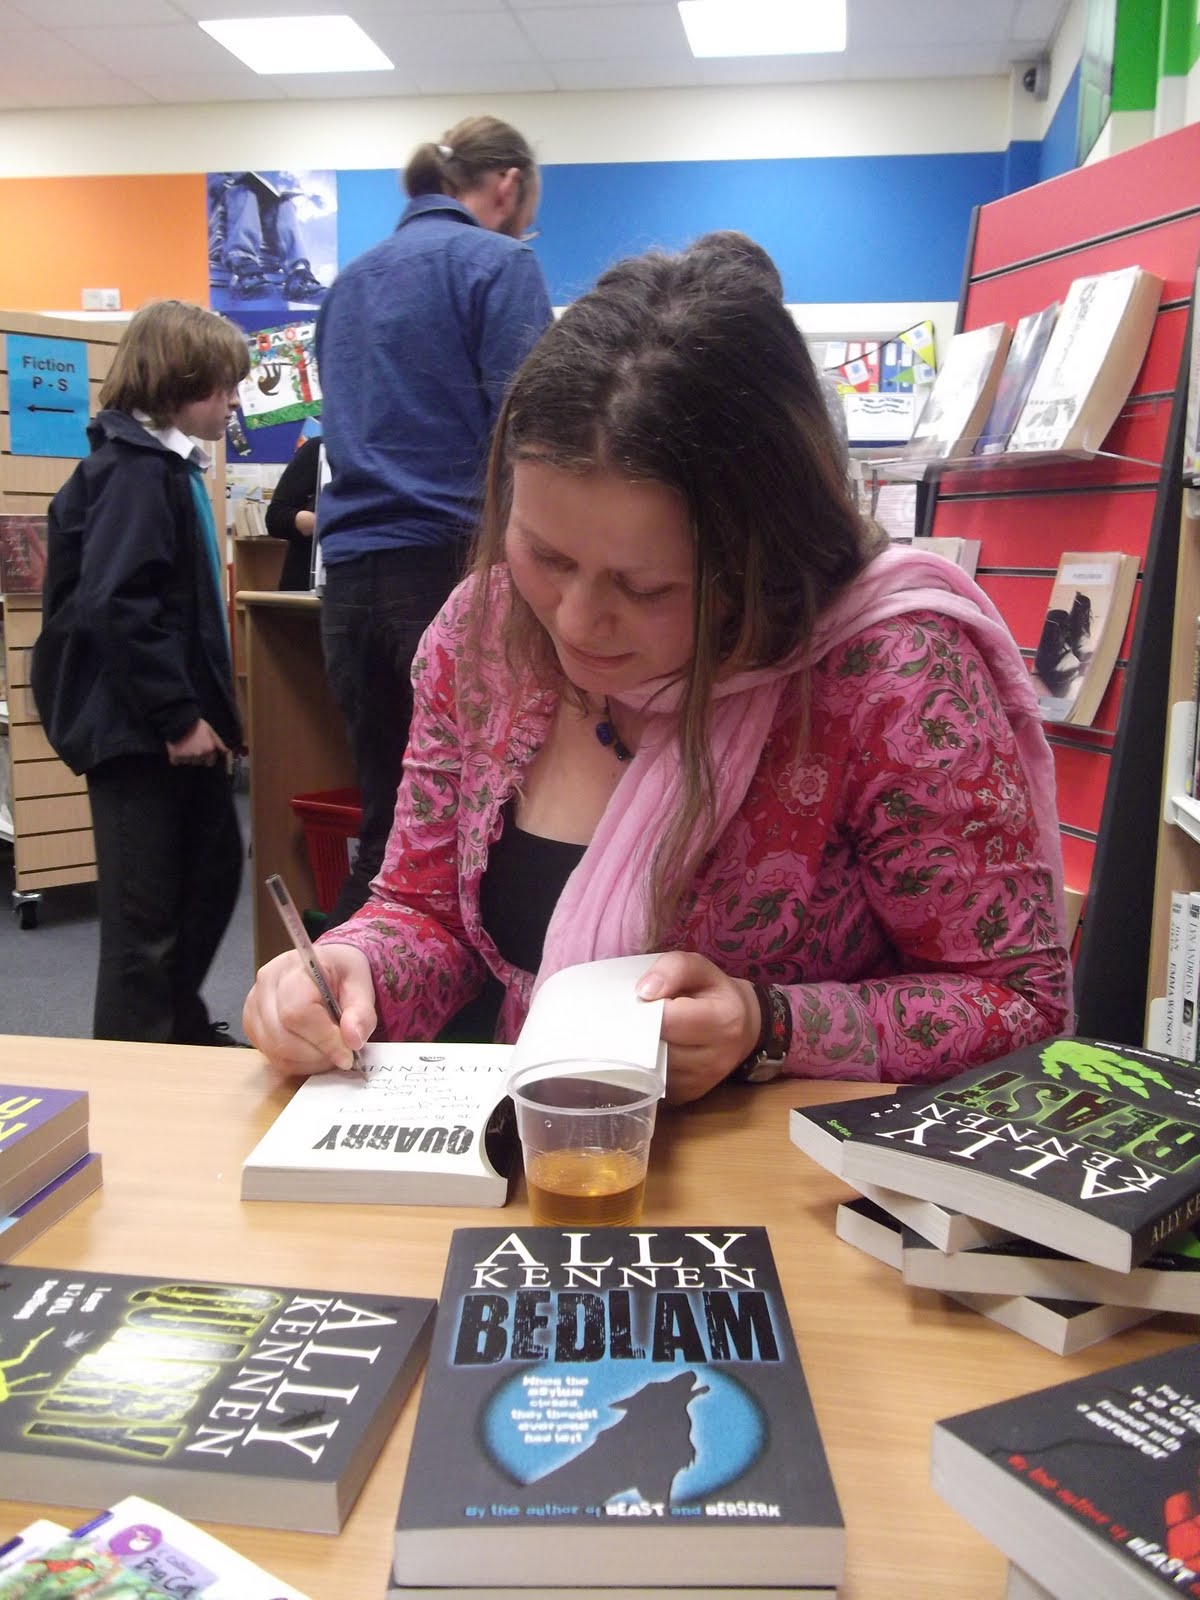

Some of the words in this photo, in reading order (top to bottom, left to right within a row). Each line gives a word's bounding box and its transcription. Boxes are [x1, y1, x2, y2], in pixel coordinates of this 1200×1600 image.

[22, 355, 76, 373] Fiction
[32, 376, 43, 389] P
[58, 378, 68, 392] S
[1167, 962, 1177, 997] EMMA
[1165, 999, 1175, 1046] WATSON
[352, 1065, 446, 1073] KENNE
[455, 1065, 507, 1073] ALLY
[934, 1071, 1200, 1173] BEAST
[312, 1124, 474, 1155] QUARRY
[912, 1102, 1167, 1192] KENNEN
[875, 1116, 1149, 1200] ALLY
[1152, 1207, 1182, 1246] ALLY
[474, 1232, 747, 1267] ALLY
[470, 1267, 757, 1288] KENNEN
[453, 1290, 781, 1366] BEDLAM
[185, 1295, 335, 1458] KENNEN
[241, 1297, 398, 1464] ALLY
[565, 1376, 589, 1386] the
[511, 1408, 543, 1420] they
[546, 1408, 598, 1420] thought
[518, 1422, 590, 1432] everyone
[491, 1504, 519, 1516] the
[526, 1504, 578, 1516] author
[586, 1505, 601, 1519] of
[606, 1501, 663, 1517] BEAST
[671, 1504, 700, 1516] and
[705, 1501, 781, 1517] BERSERK
